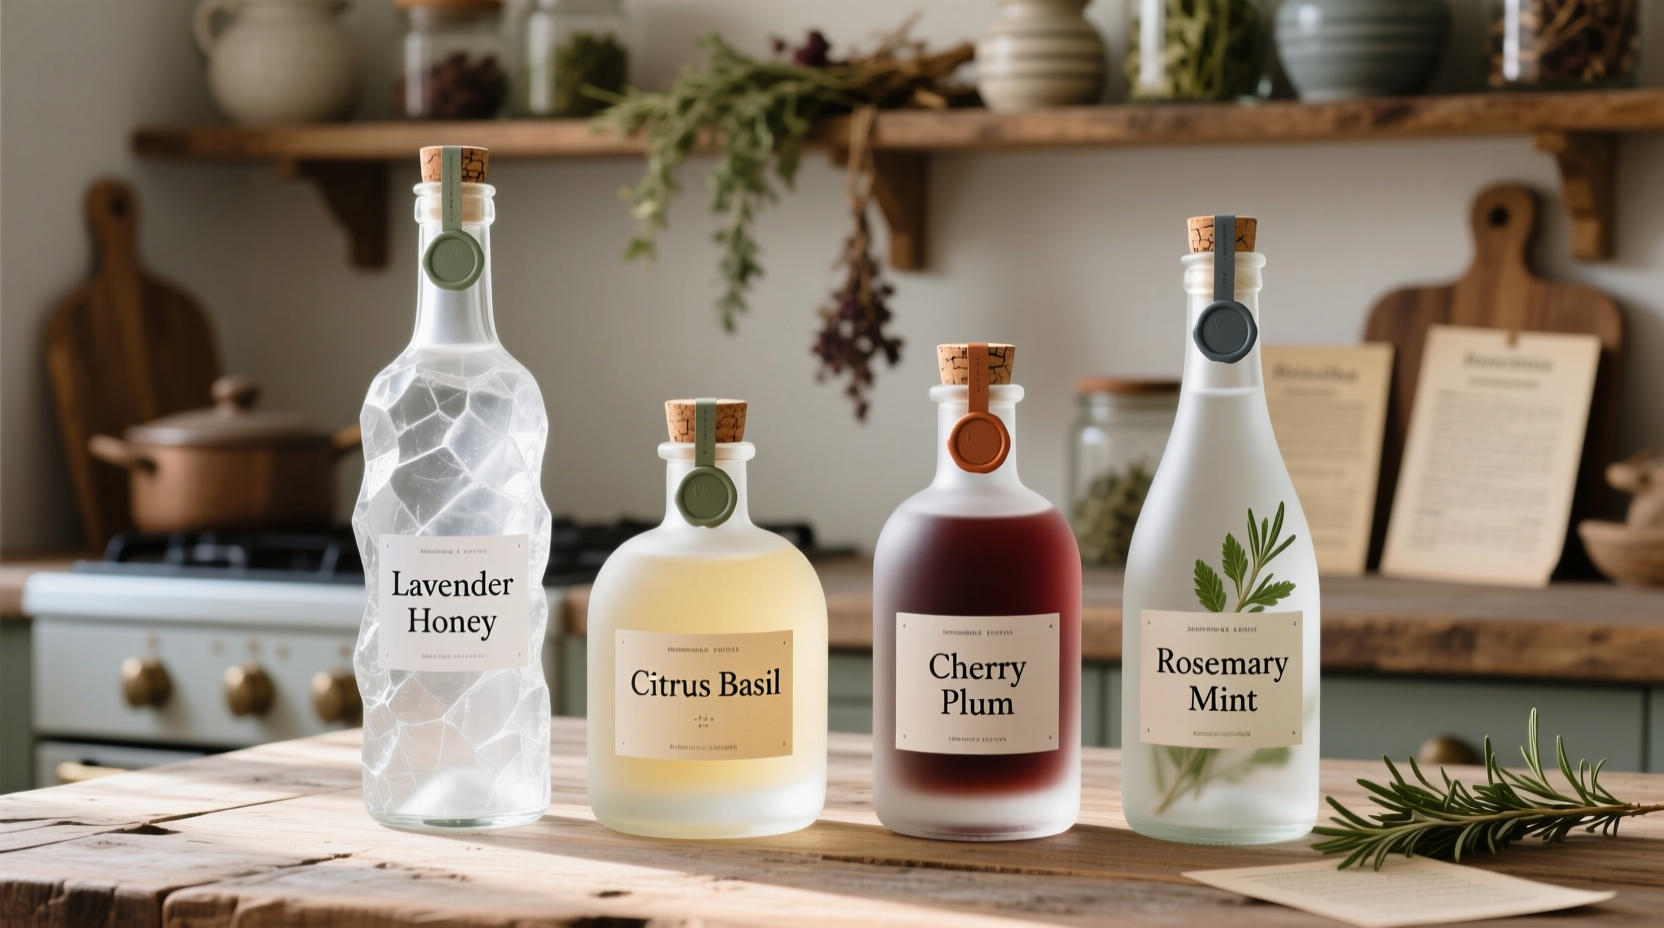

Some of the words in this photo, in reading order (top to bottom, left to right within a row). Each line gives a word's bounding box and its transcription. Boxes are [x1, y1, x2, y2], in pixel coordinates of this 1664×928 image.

[391, 569, 514, 598] Lavender
[408, 607, 497, 642] Honey
[929, 652, 1028, 688] Cherry
[1156, 647, 1289, 683] Rosemary
[631, 669, 711, 698] Citrus
[718, 667, 781, 697] Basil
[940, 687, 1016, 717] Plum
[1188, 685, 1258, 712] Mint
